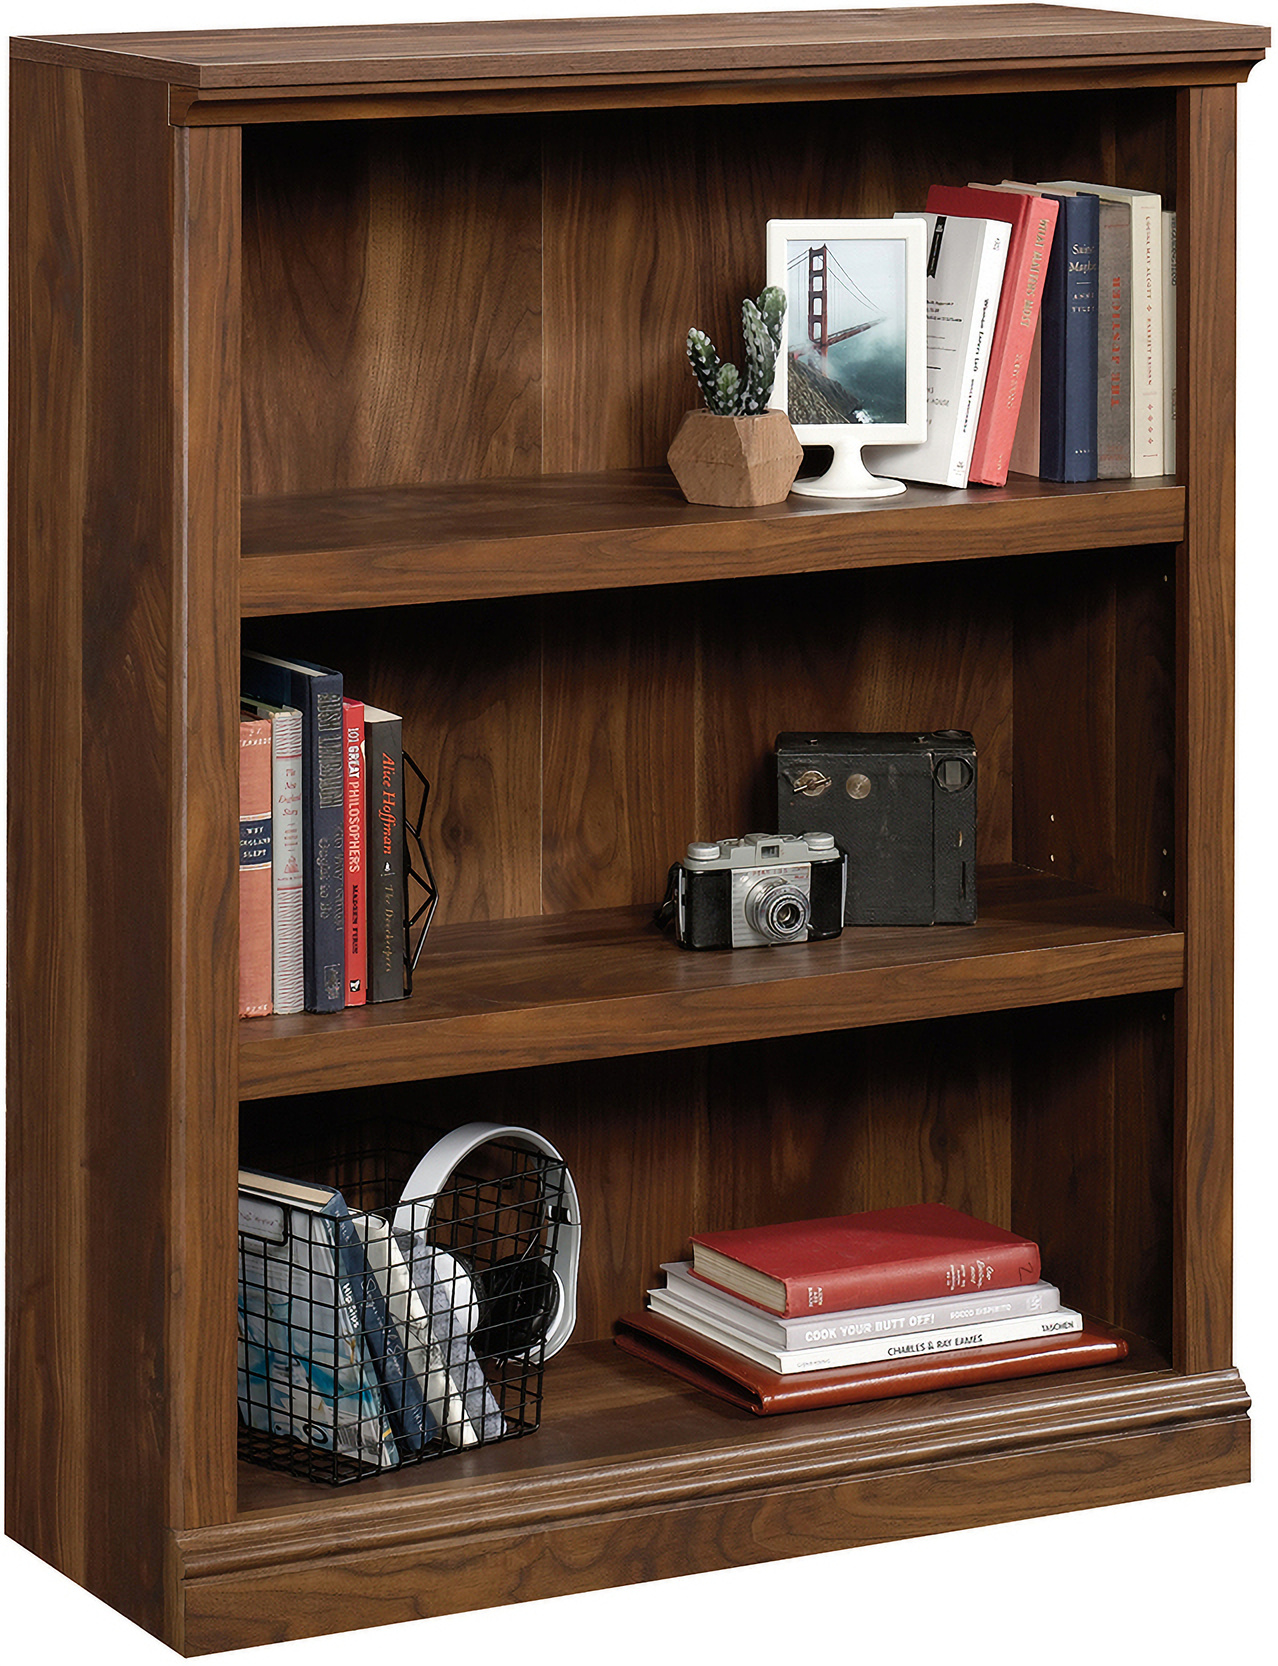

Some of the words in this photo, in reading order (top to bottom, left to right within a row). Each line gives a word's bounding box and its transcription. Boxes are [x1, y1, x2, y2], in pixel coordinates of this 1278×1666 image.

[1036, 218, 1050, 246] WHAT
[1026, 250, 1044, 297] MATTERS
[1020, 299, 1034, 328] MOST
[1110, 276, 1122, 364] JUSTICER
[1110, 371, 1121, 407] THE
[347, 727, 360, 743] 101
[348, 745, 361, 779] GREAT
[381, 752, 396, 789] Alice
[347, 781, 361, 873] PHILOSOPHERS
[378, 790, 396, 855] Hoffman
[383, 884, 394, 905] The
[805, 1327, 838, 1342] COOK
[840, 1321, 871, 1336] YOUR
[875, 1316, 905, 1332] BUTT
[909, 1313, 935, 1328] OFF!
[949, 1309, 974, 1320] ROCCO
[887, 1341, 926, 1356] CHARLES
[927, 1340, 935, 1351] &
[936, 1337, 953, 1349] RAY
[954, 1333, 983, 1346] EAMES
